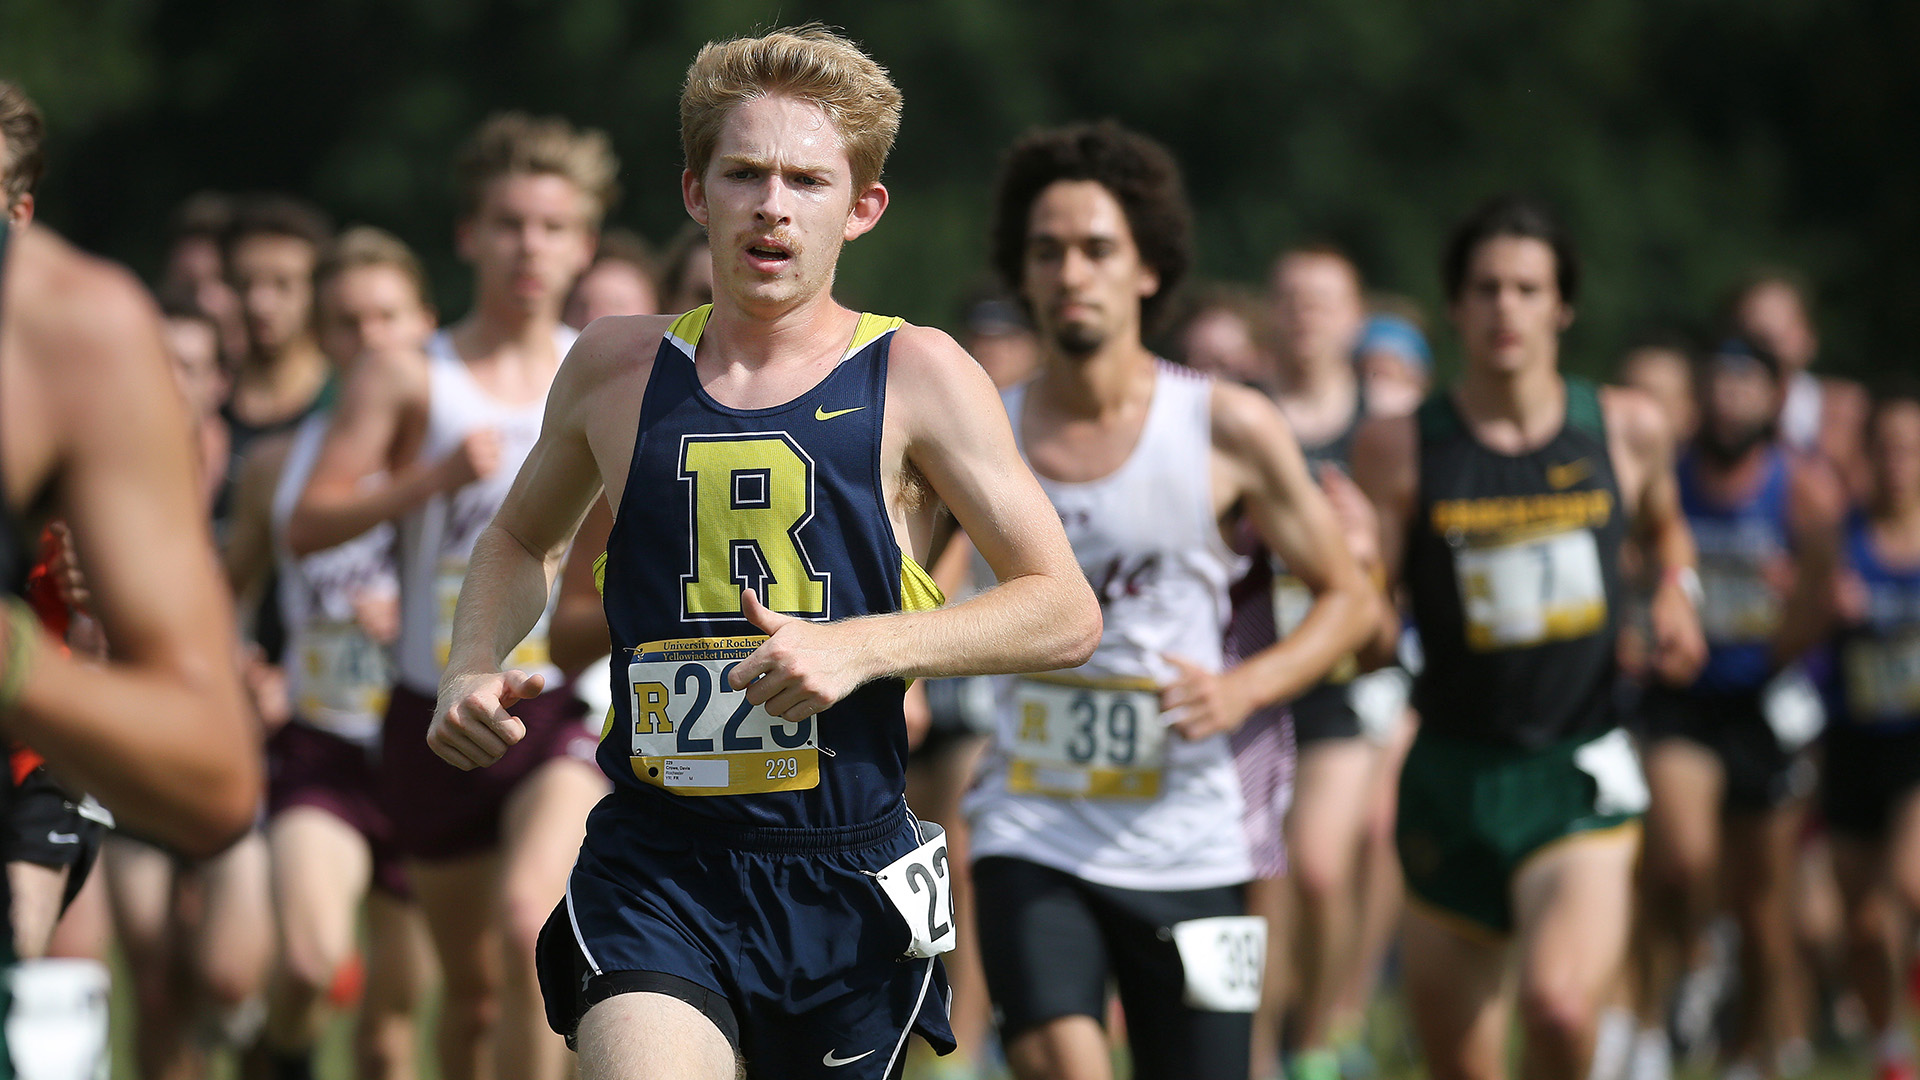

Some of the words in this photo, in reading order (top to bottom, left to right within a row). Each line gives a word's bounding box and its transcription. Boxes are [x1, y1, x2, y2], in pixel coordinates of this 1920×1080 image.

[677, 431, 830, 622] R
[663, 639, 712, 650] University
[713, 639, 725, 648] of
[726, 638, 766, 648] Rochest
[663, 651, 718, 661] Yellowjacket
[720, 650, 754, 659] Invitat
[633, 681, 674, 734] R
[1067, 690, 1138, 765] 39
[765, 757, 798, 779] 229
[906, 846, 955, 943] 22
